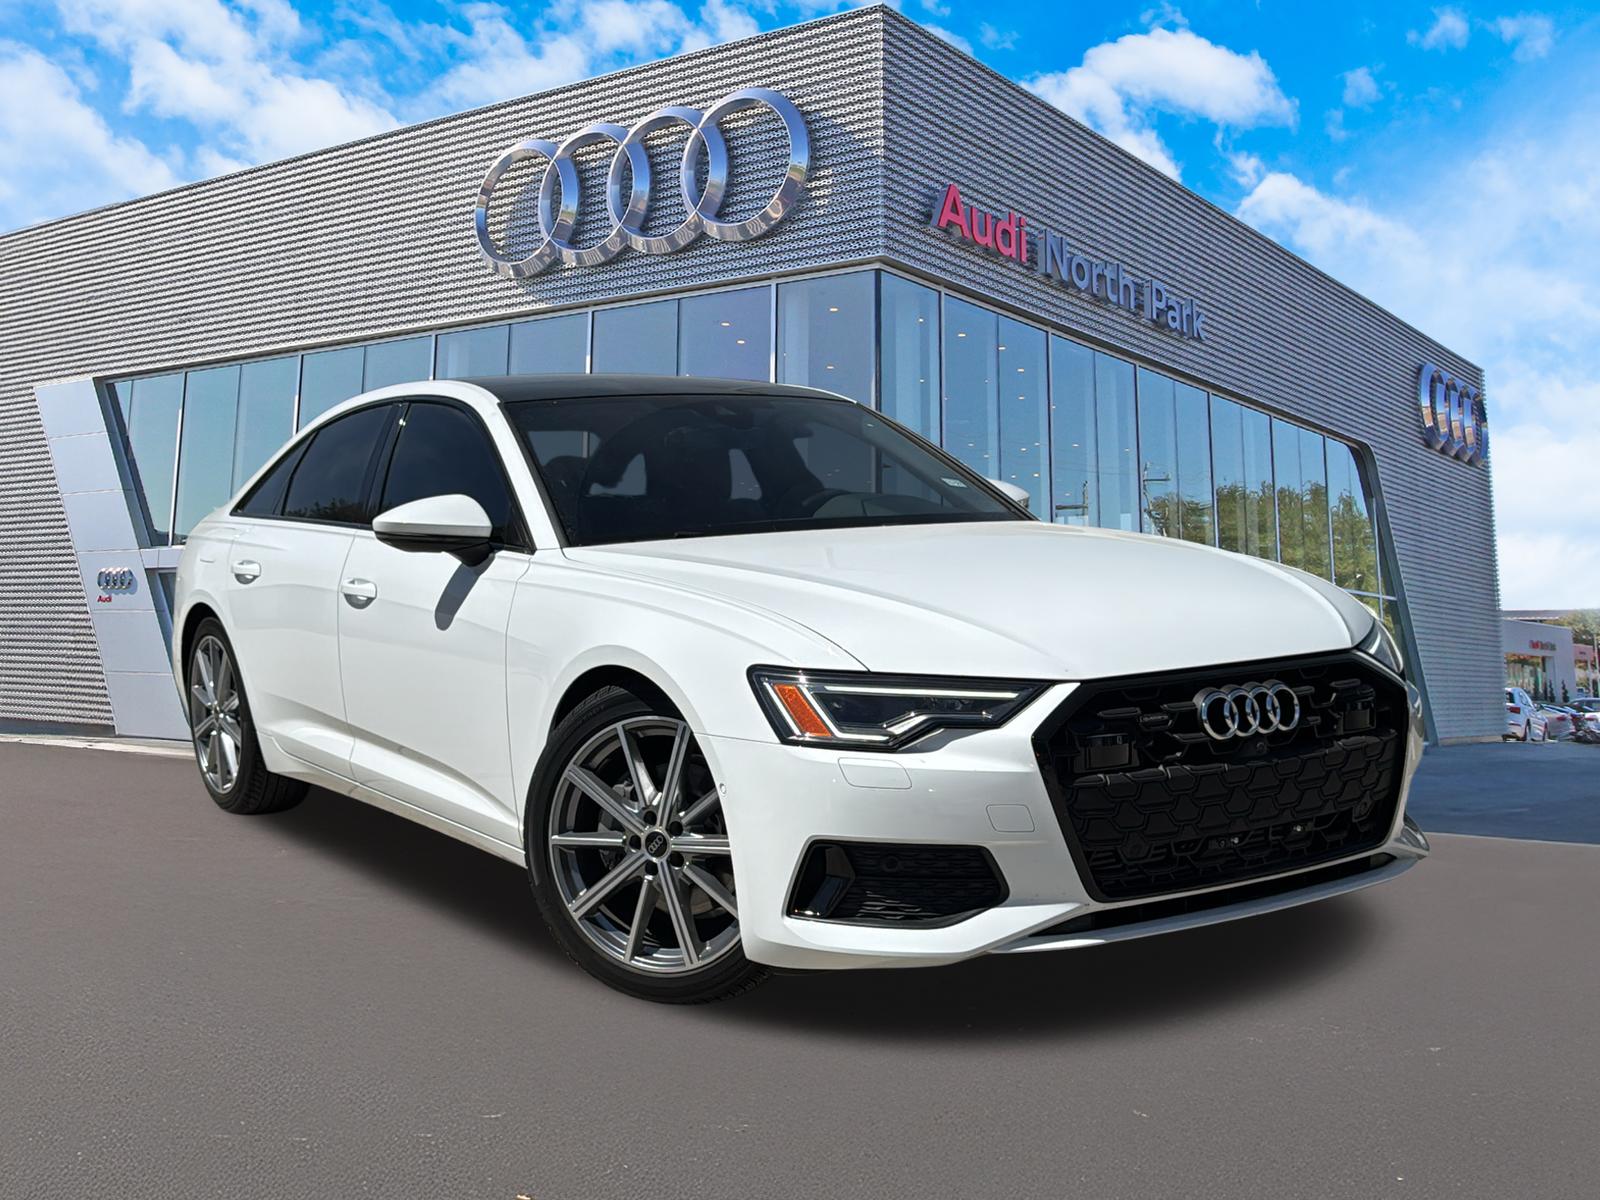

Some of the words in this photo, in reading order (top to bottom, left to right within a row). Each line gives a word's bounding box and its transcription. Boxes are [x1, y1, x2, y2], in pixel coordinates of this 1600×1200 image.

[932, 183, 1028, 262] Audi
[1039, 230, 1136, 312] North
[1144, 278, 1206, 340] Park
